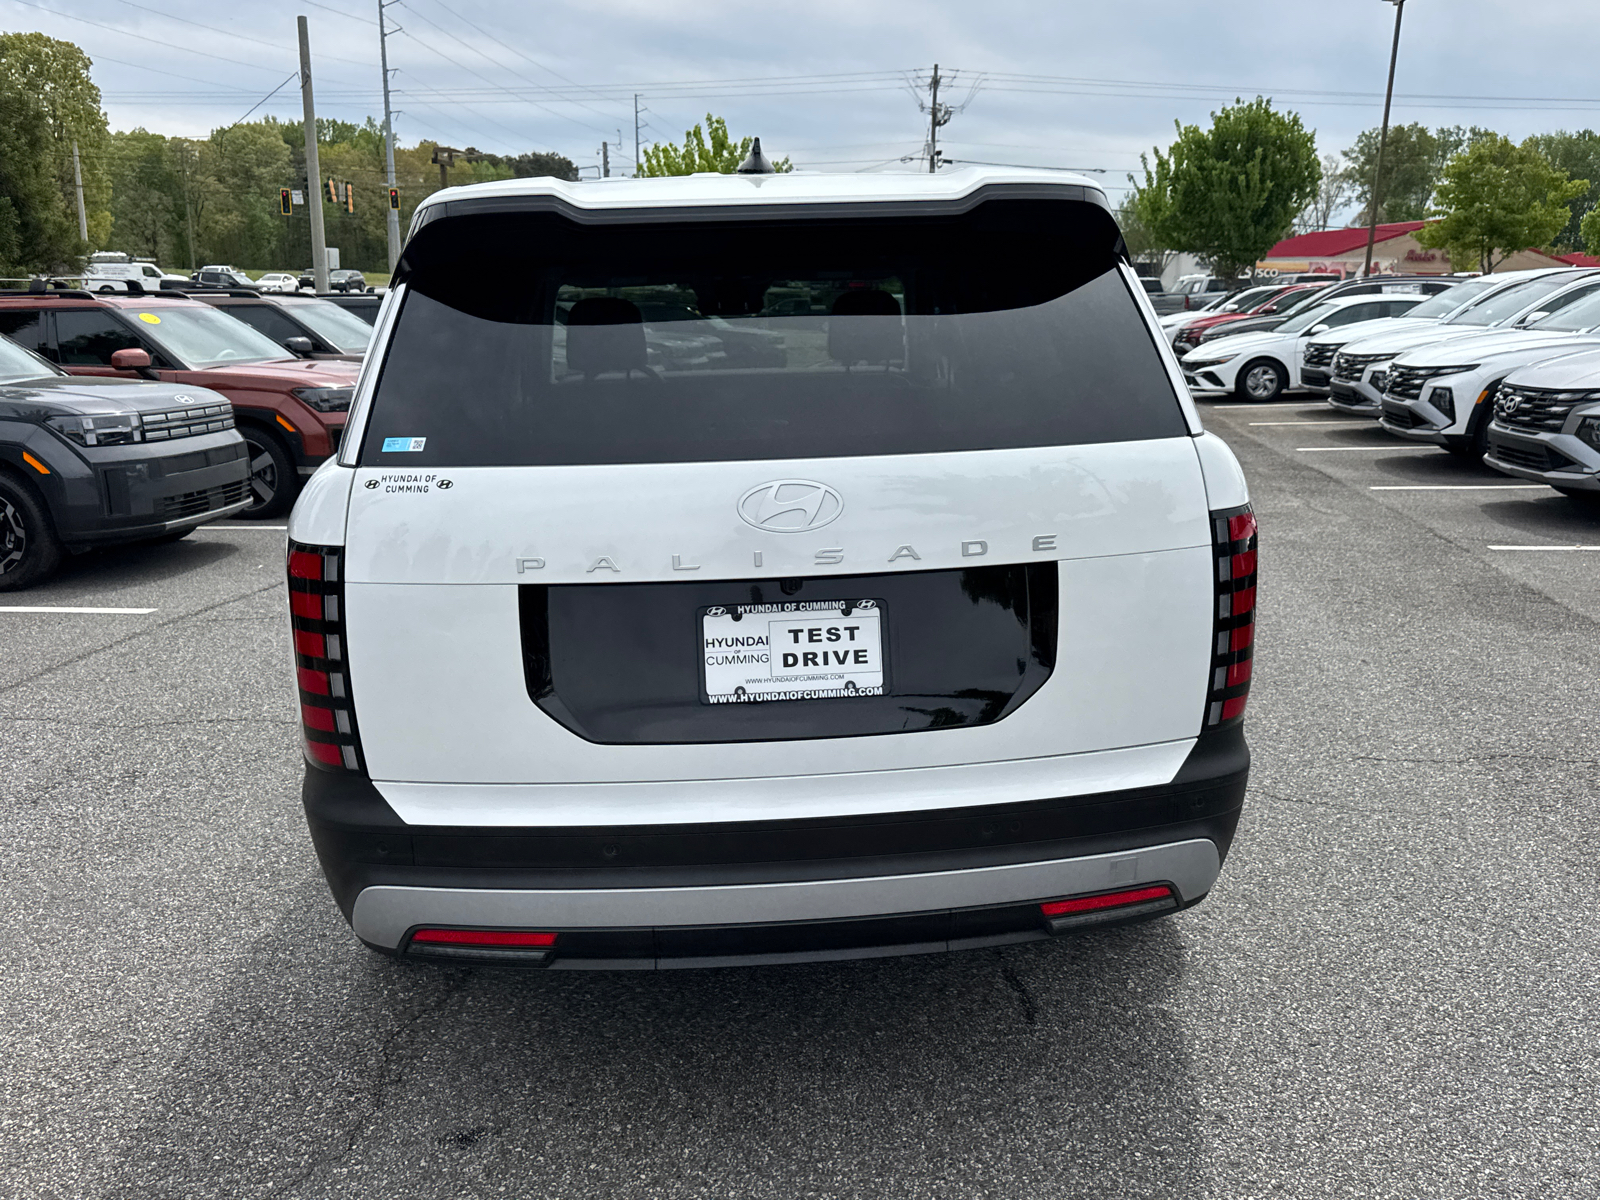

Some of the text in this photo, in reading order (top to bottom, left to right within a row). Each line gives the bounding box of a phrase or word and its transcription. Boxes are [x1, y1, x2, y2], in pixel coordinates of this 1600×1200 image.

[381, 474, 437, 483] HYUNDAI OF
[385, 485, 430, 493] CUMMING
[515, 534, 1059, 574] PALISADE
[737, 600, 846, 615] HYUNDAI OF CUMMING
[705, 635, 769, 649] HYUNDAI
[788, 626, 860, 644] TEST
[706, 653, 770, 666] CUMMING
[782, 649, 869, 668] DRIVE
[744, 674, 845, 685] WWW.HYUNDAIOFCUMMING.COM
[708, 686, 883, 704] WWW.HYUNDAIOFCUMMING.COM
